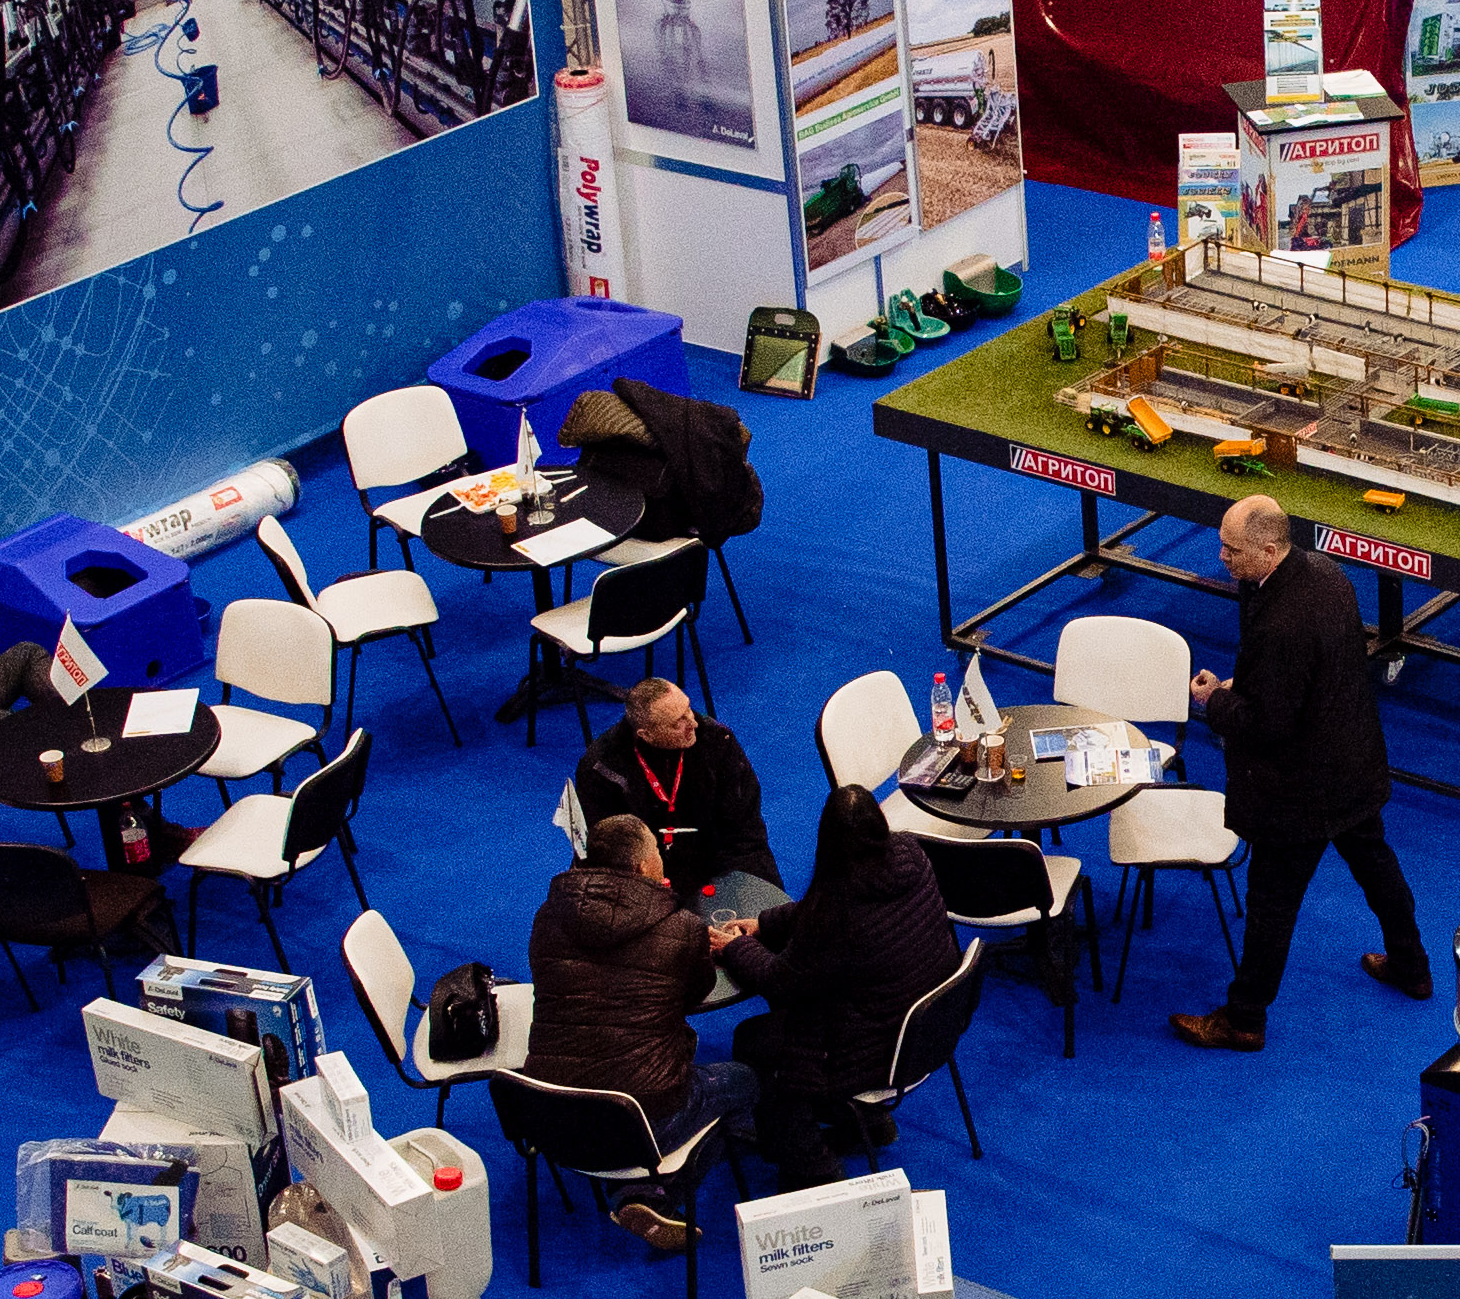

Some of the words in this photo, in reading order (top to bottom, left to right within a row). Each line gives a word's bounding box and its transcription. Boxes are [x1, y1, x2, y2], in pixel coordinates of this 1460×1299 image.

[1292, 134, 1379, 161] АГРИТОП
[575, 155, 603, 255] Polywrap
[1019, 452, 1116, 496] АГРИТОП
[1327, 530, 1431, 578] АГРИТОП
[147, 1001, 186, 1021] Safety
[91, 1023, 142, 1054] White
[97, 1044, 120, 1061] milk
[120, 1052, 152, 1070] filters
[71, 1224, 95, 1237] Calf
[94, 1227, 118, 1238] coat
[755, 1224, 824, 1251] White
[758, 1248, 790, 1265] milk
[792, 1238, 835, 1256] filters
[759, 1262, 789, 1274] Sewn
[789, 1254, 815, 1267] sock
